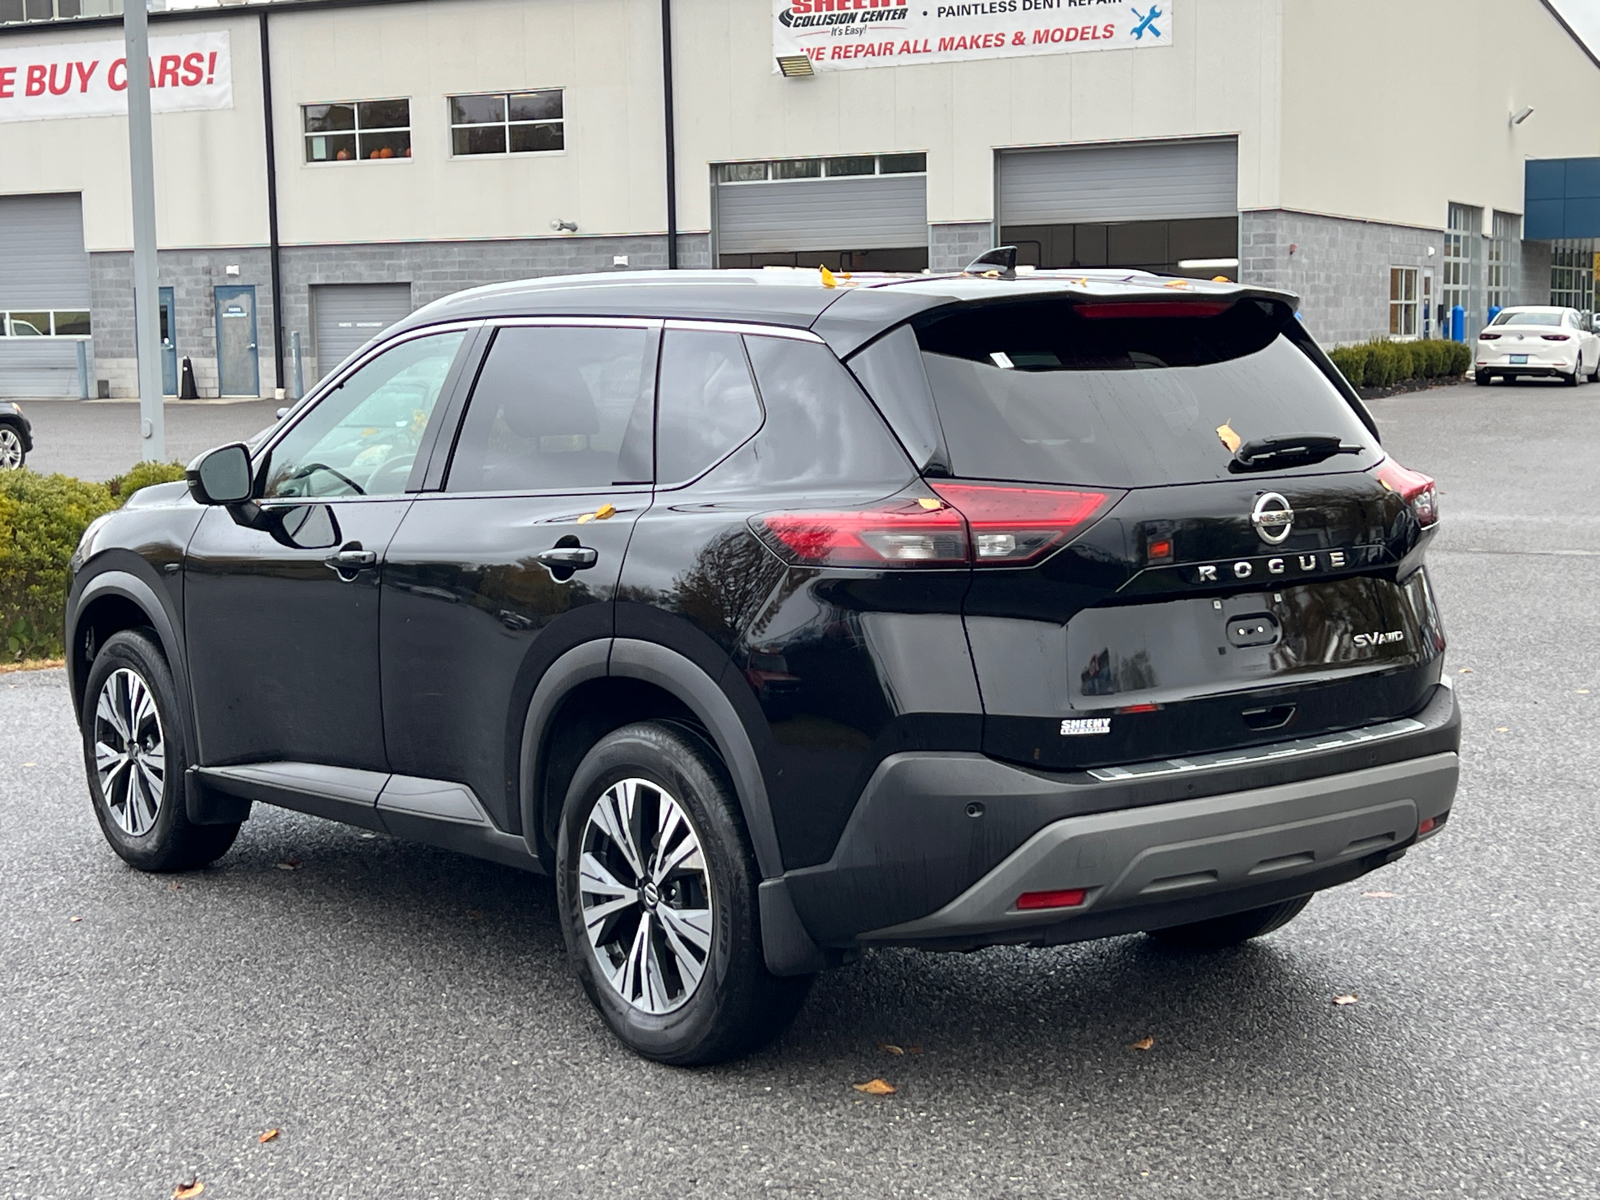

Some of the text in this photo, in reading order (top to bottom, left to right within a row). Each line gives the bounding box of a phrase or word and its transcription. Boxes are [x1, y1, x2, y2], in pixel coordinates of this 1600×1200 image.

[792, 8, 909, 28] COLLISION CENTER
[937, 1, 1018, 18] PAINTLESS
[1022, 0, 1063, 11] DENT
[831, 24, 868, 37] It's Easy!
[831, 41, 895, 60] REPAIR
[898, 38, 932, 55] ALL
[938, 32, 1006, 52] MAKES
[1011, 31, 1026, 46] &
[1032, 23, 1115, 45] MODELS
[0, 66, 17, 98] E
[25, 60, 100, 97] BUY
[1197, 551, 1346, 582] ROGUE
[1353, 631, 1379, 648] SV
[1060, 718, 1111, 729] SHEEHY
